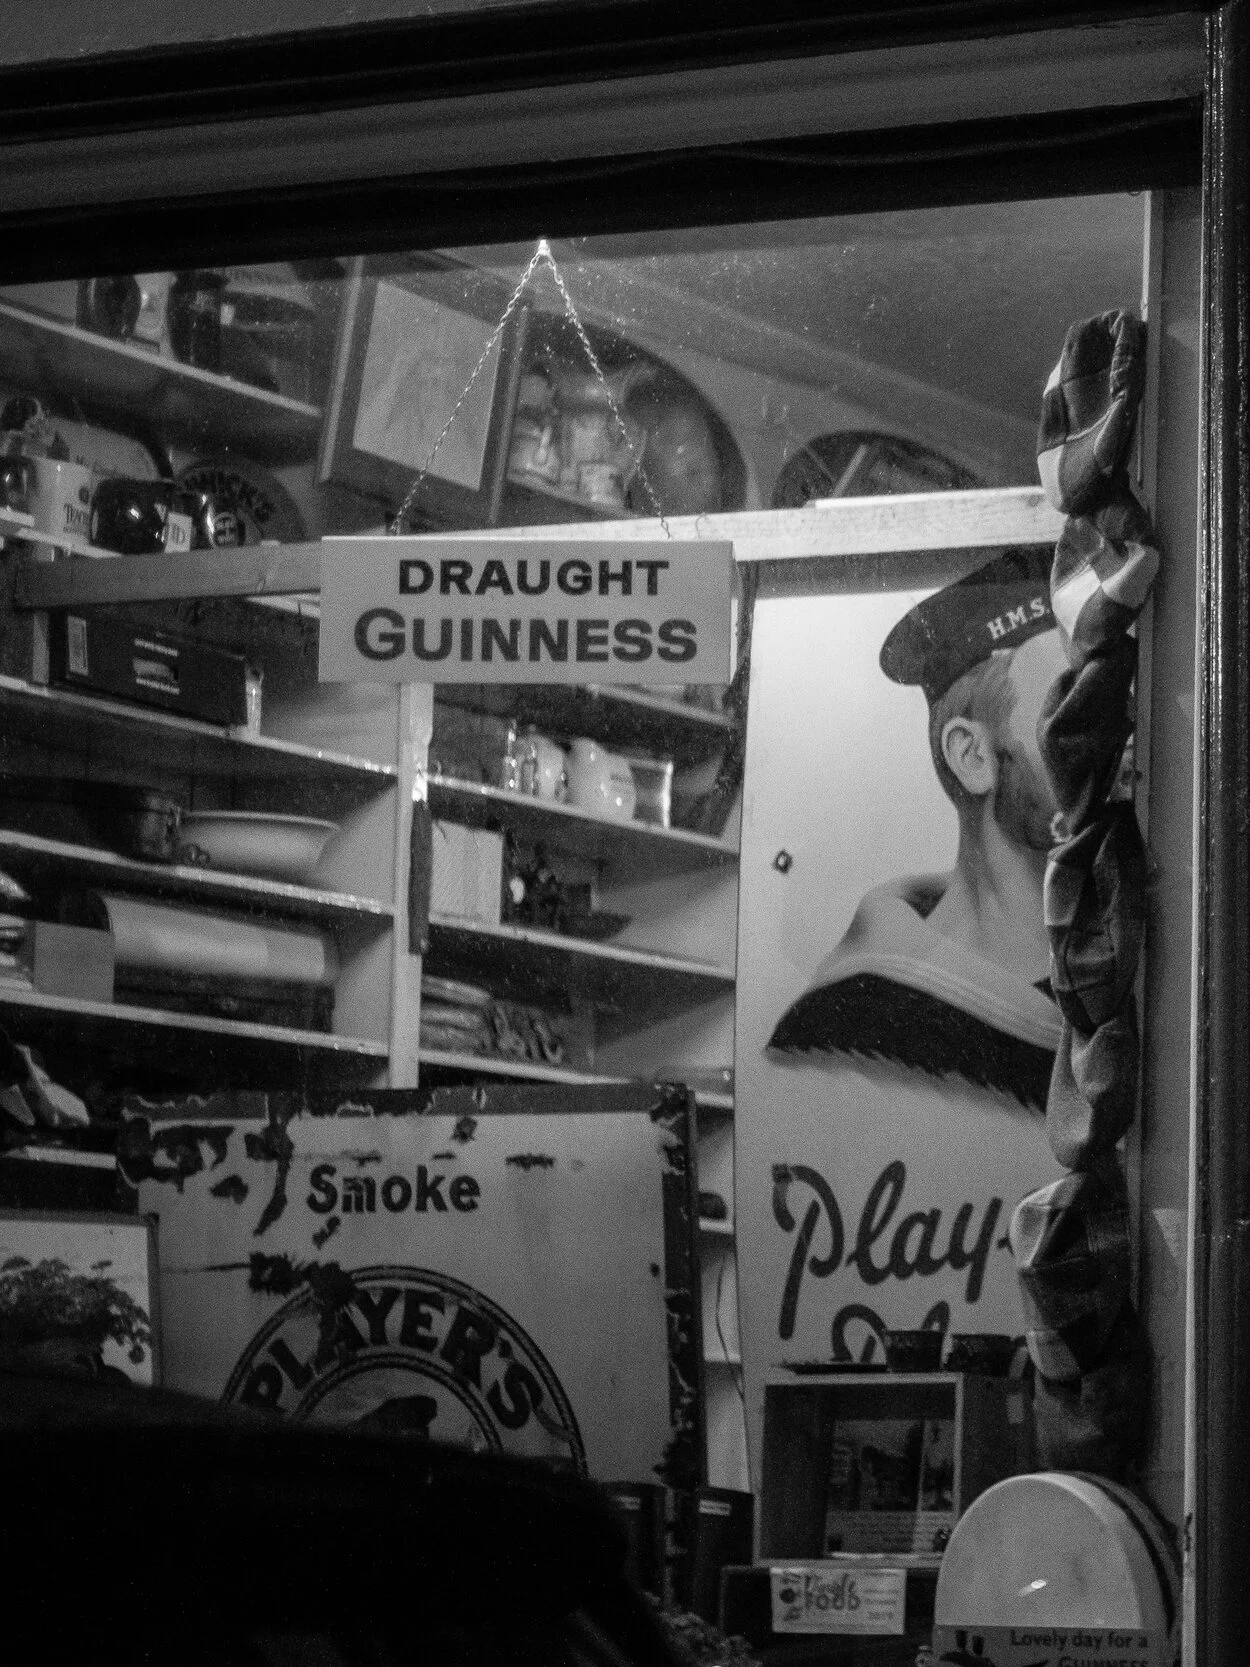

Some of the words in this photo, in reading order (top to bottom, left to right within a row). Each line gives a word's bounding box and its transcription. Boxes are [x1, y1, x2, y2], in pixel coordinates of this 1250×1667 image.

[398, 558, 669, 596] DRAUGHT
[353, 607, 698, 664] GUINNESS
[306, 1164, 481, 1214] Smoke
[239, 1286, 545, 1431] PLAYER'S
[1010, 1628, 1067, 1651] Lovely
[1072, 1630, 1102, 1652] day
[1107, 1631, 1133, 1649] for
[1137, 1636, 1149, 1648] a
